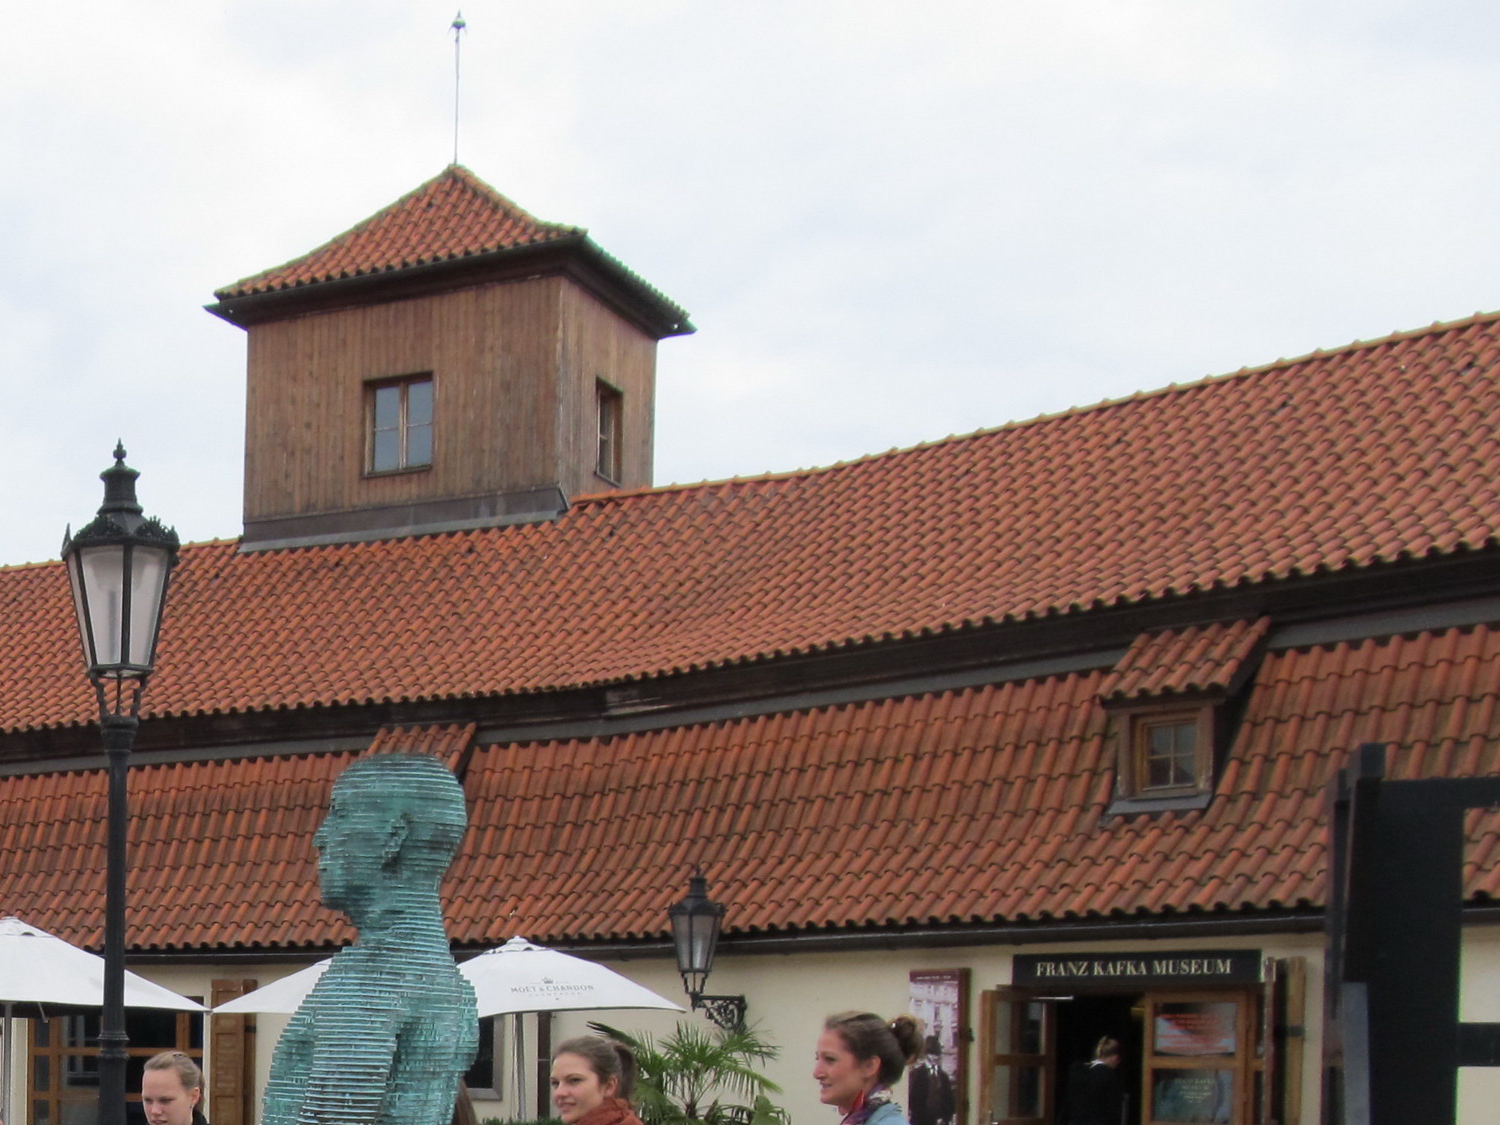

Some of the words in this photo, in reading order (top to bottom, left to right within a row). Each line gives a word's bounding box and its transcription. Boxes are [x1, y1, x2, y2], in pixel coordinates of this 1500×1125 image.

[1036, 961, 1088, 977] FRANZ
[1093, 960, 1147, 976] KAFKA
[1153, 958, 1233, 975] MUSEUM
